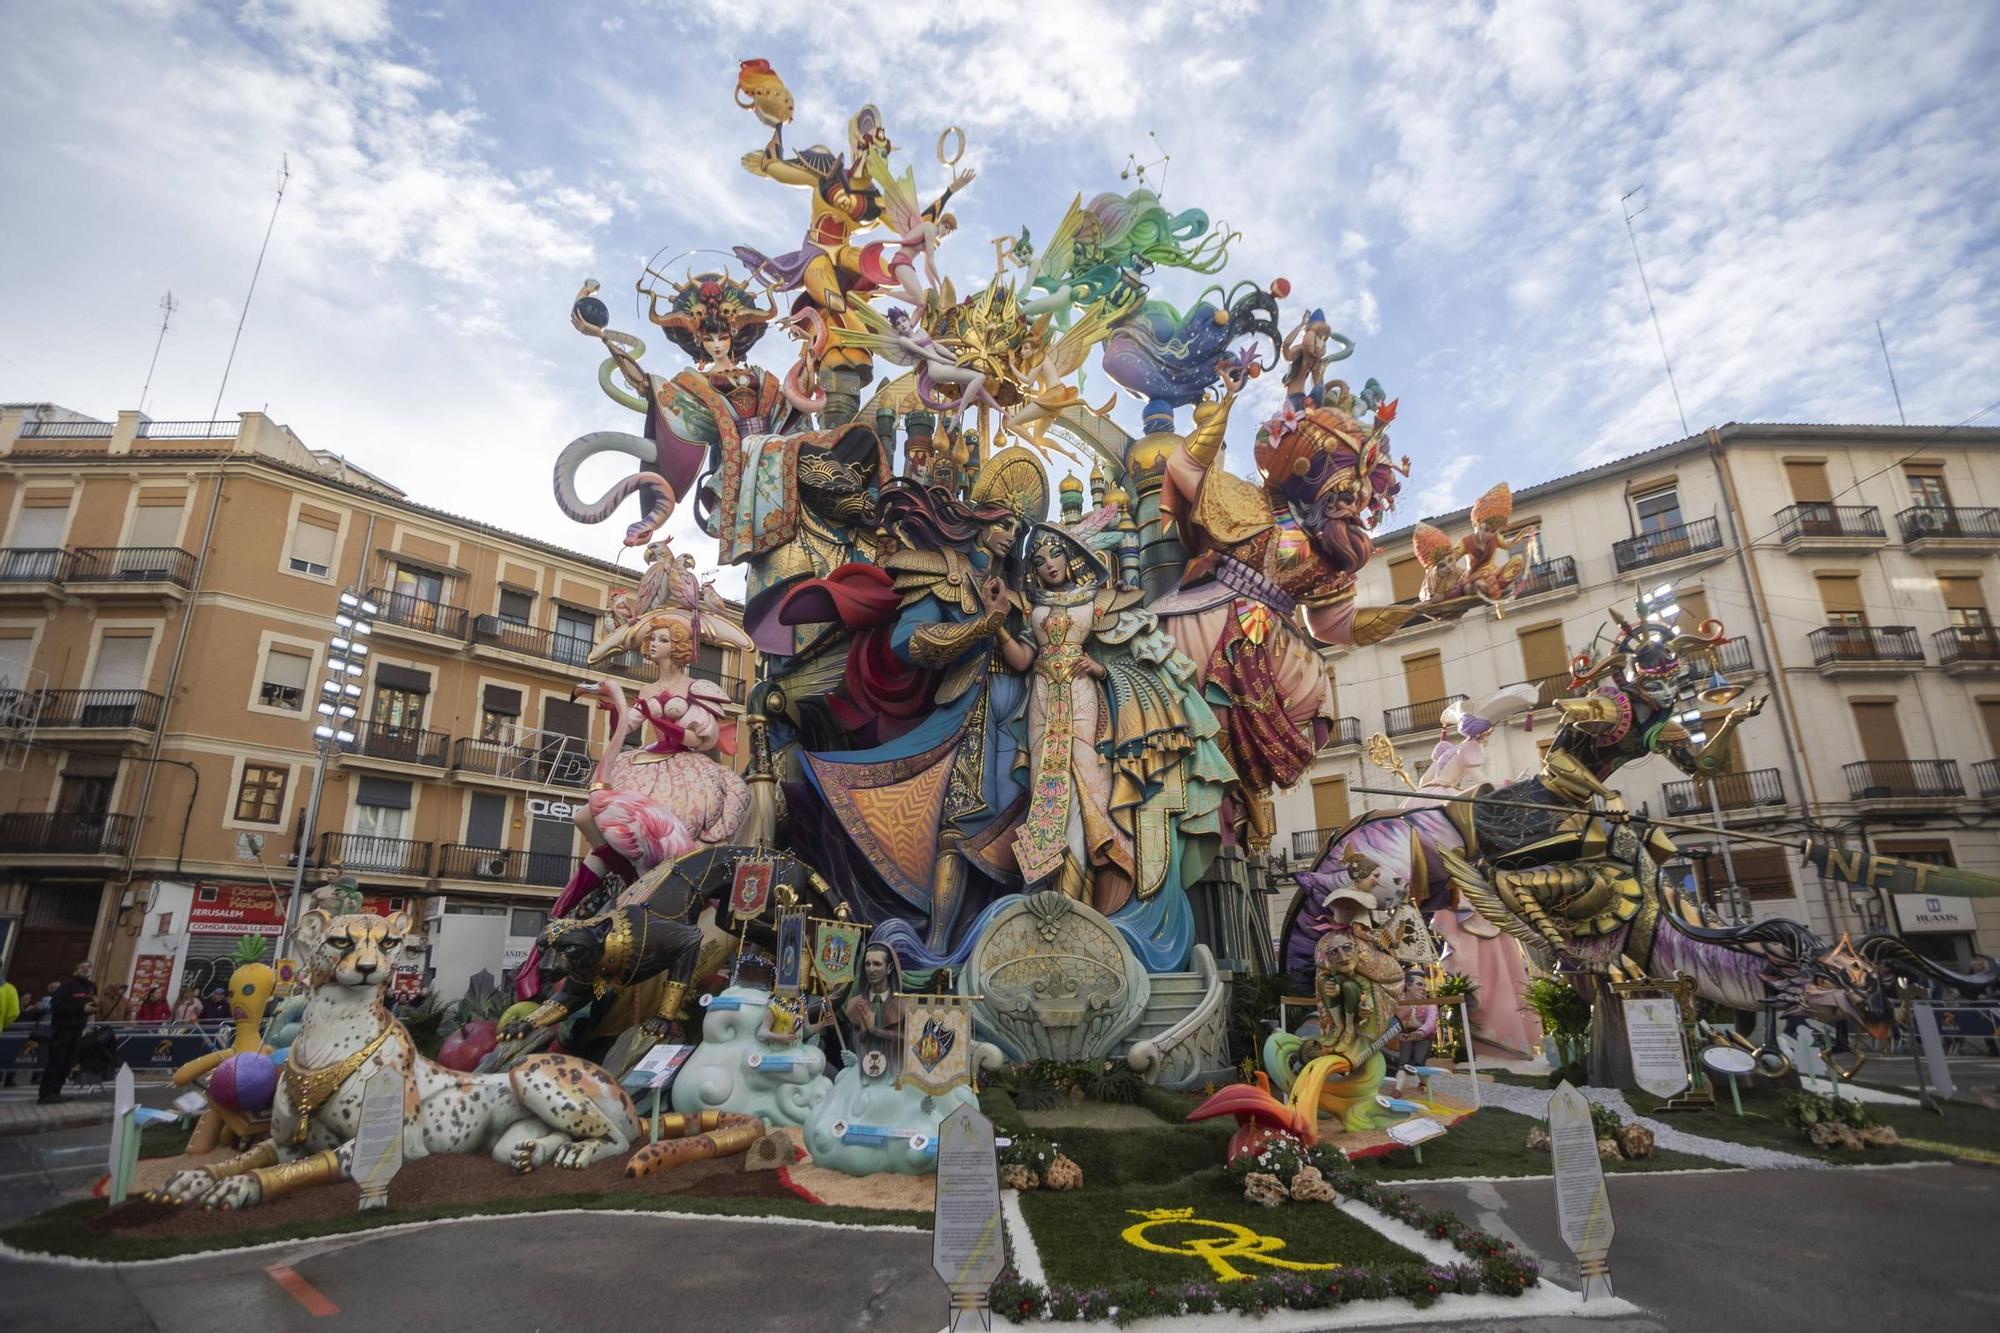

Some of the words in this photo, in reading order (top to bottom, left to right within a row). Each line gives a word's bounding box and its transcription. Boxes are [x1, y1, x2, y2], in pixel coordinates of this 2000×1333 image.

[1824, 848, 1940, 893] NFT
[192, 908, 244, 918] JERUSALEM
[1915, 913, 1958, 922] HUAXIN
[192, 923, 226, 931] COMIDA
[227, 924, 249, 932] PARA
